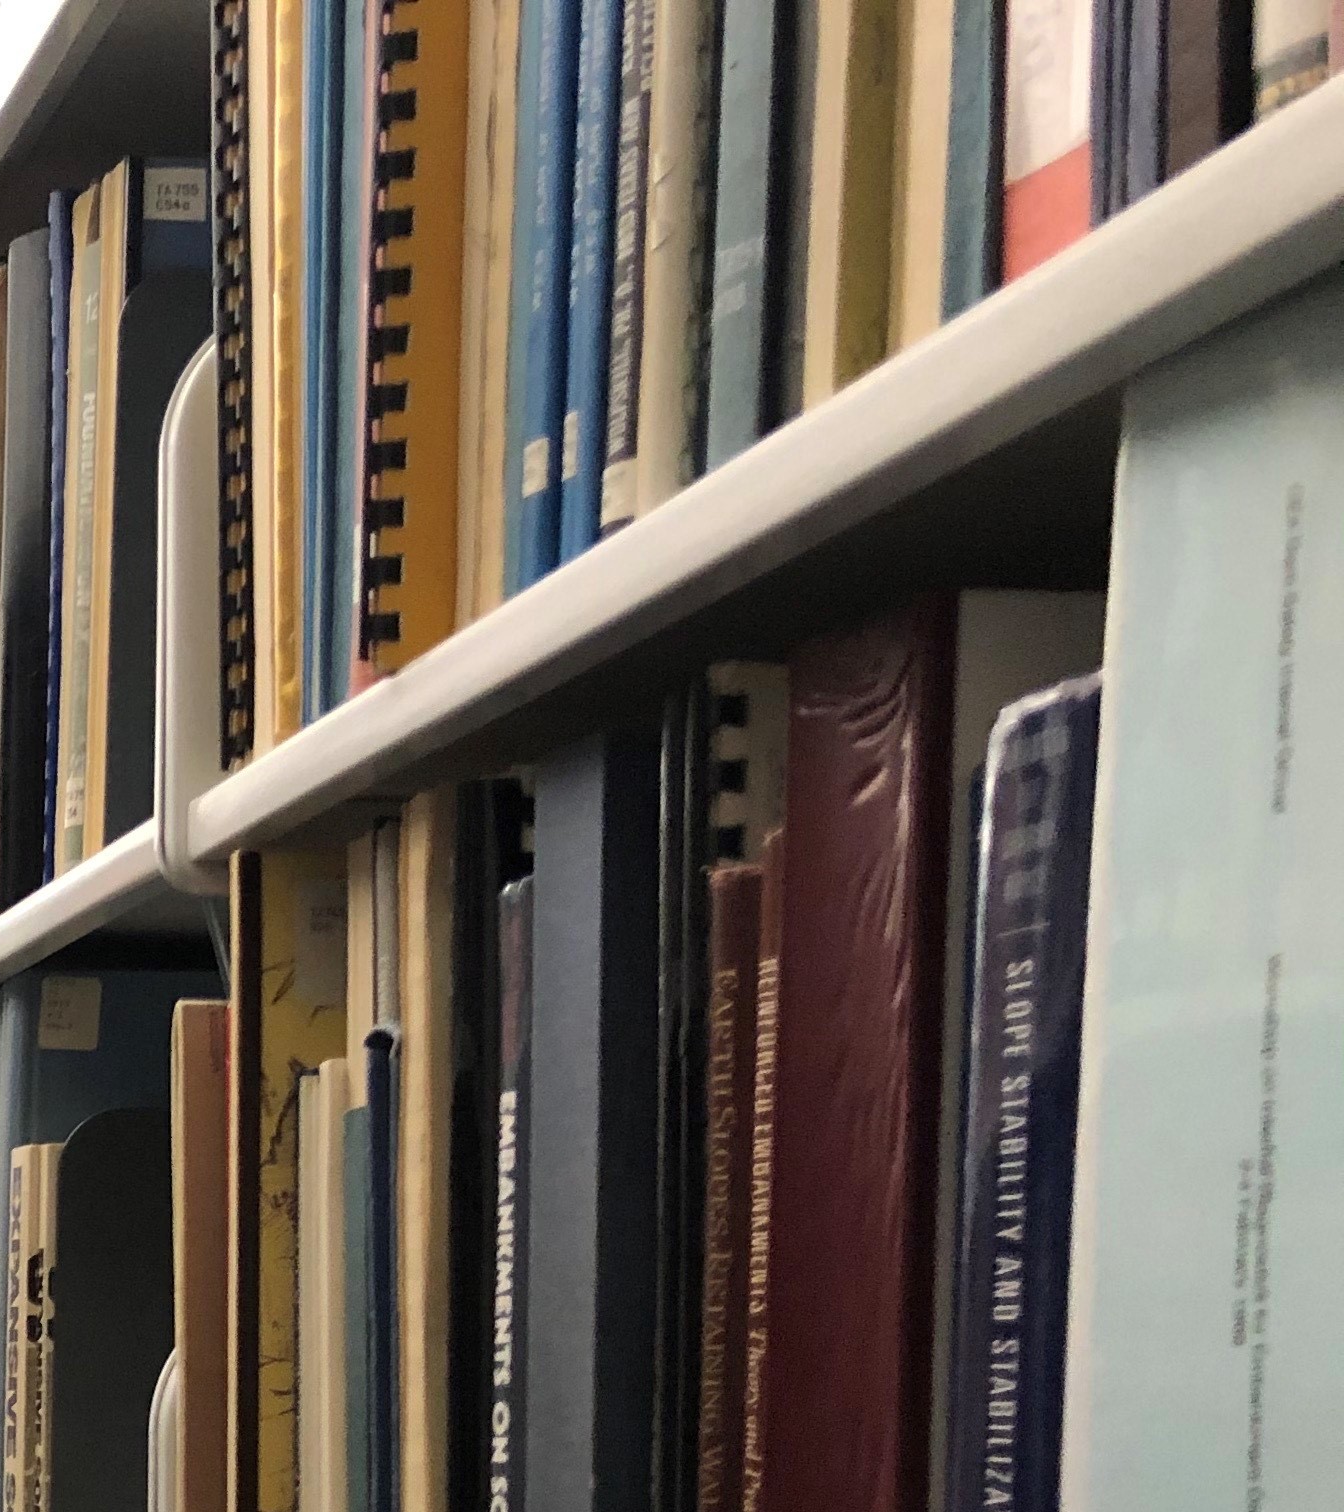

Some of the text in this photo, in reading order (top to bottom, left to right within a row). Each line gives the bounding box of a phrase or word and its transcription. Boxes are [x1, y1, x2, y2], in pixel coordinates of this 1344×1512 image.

[711, 967, 739, 1097] EARTH
[754, 957, 778, 1114] REINFORCED
[1002, 958, 1035, 1059] SLOPE
[748, 1122, 773, 1315] EMBANKMENTS
[994, 1074, 1032, 1242] STABILITY
[493, 1090, 518, 1387] EMBANKMENTS
[992, 1256, 1023, 1322] AND
[5, 1166, 23, 1460] EXPANSIVE
[490, 1400, 512, 1463] ON
[743, 1413, 763, 1461] and
